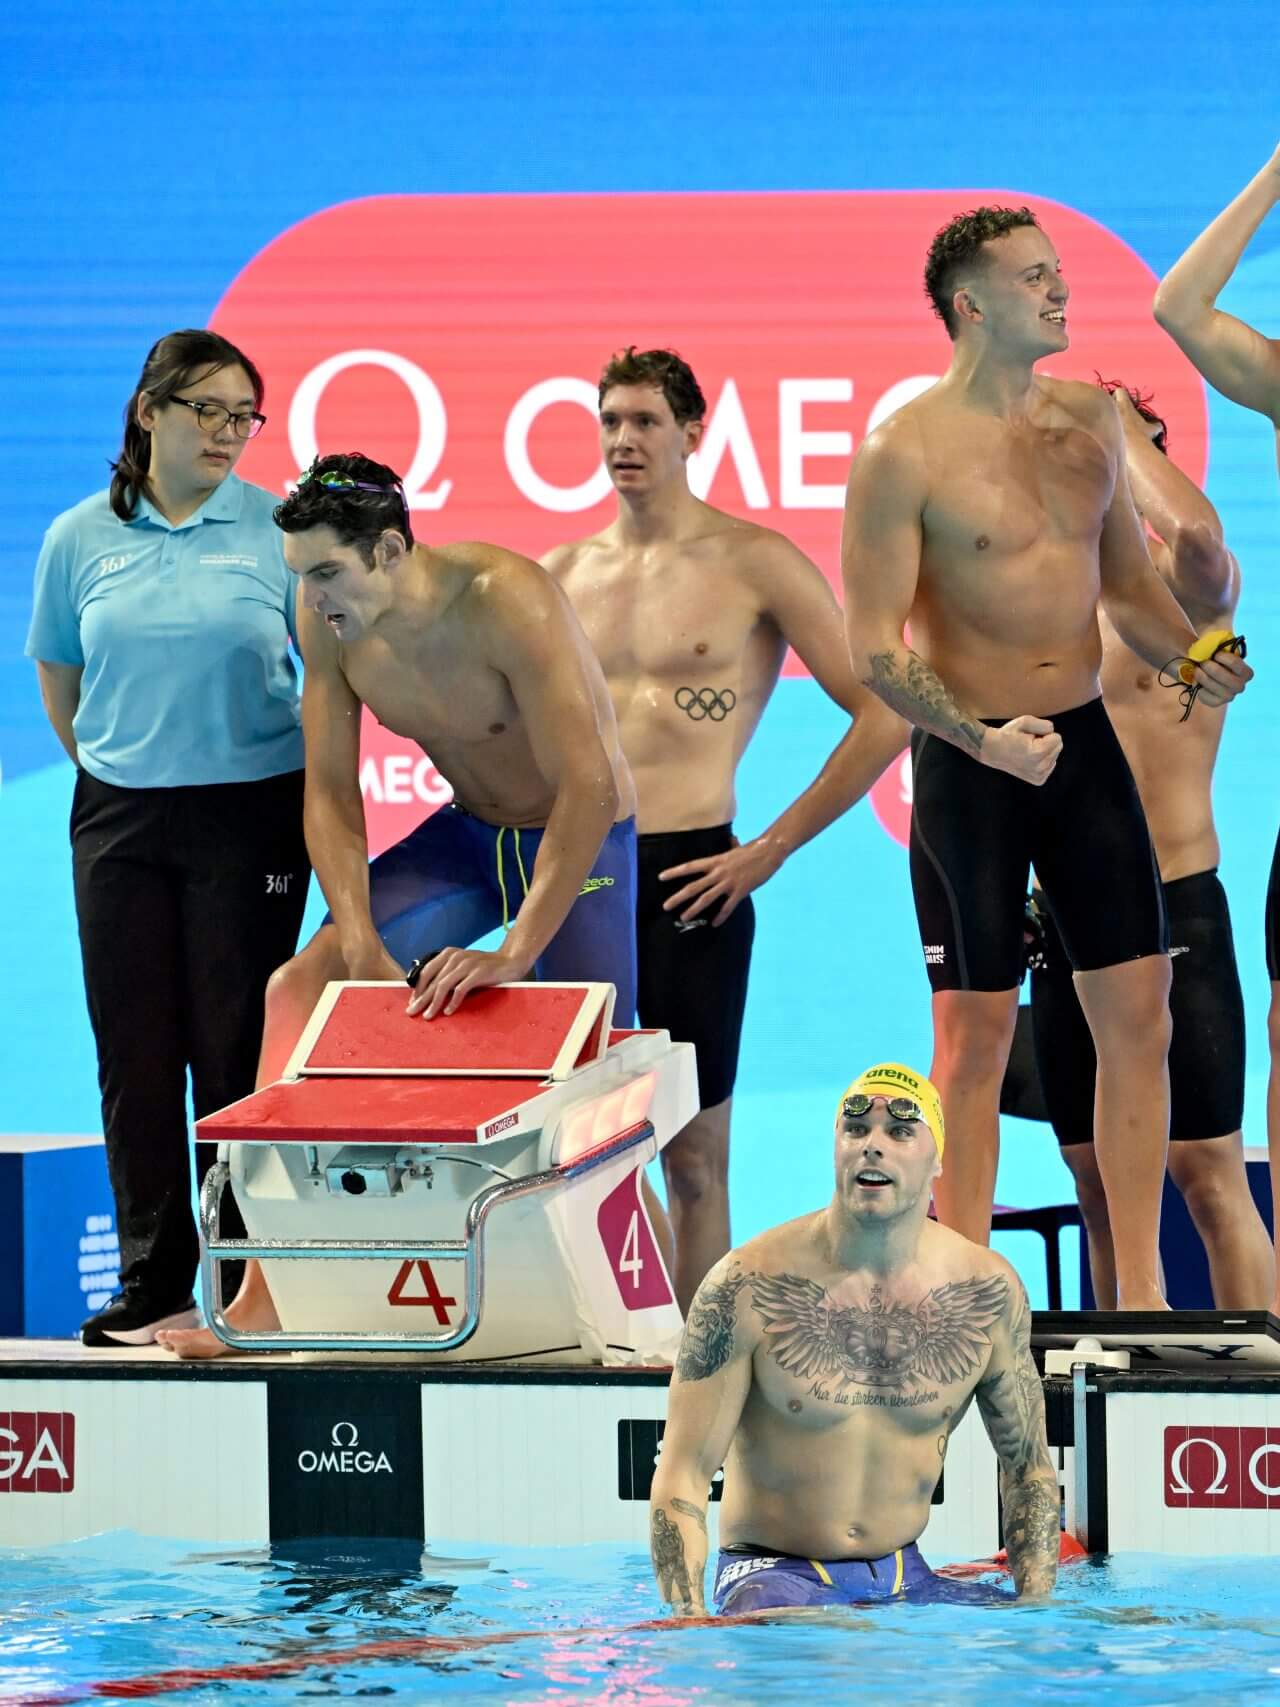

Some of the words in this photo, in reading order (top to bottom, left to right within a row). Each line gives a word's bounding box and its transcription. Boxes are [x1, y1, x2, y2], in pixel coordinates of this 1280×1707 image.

[866, 1068, 919, 1089] arena
[619, 1210, 644, 1289] 4
[387, 1260, 457, 1326] 4
[298, 1450, 393, 1474] OMEGA
